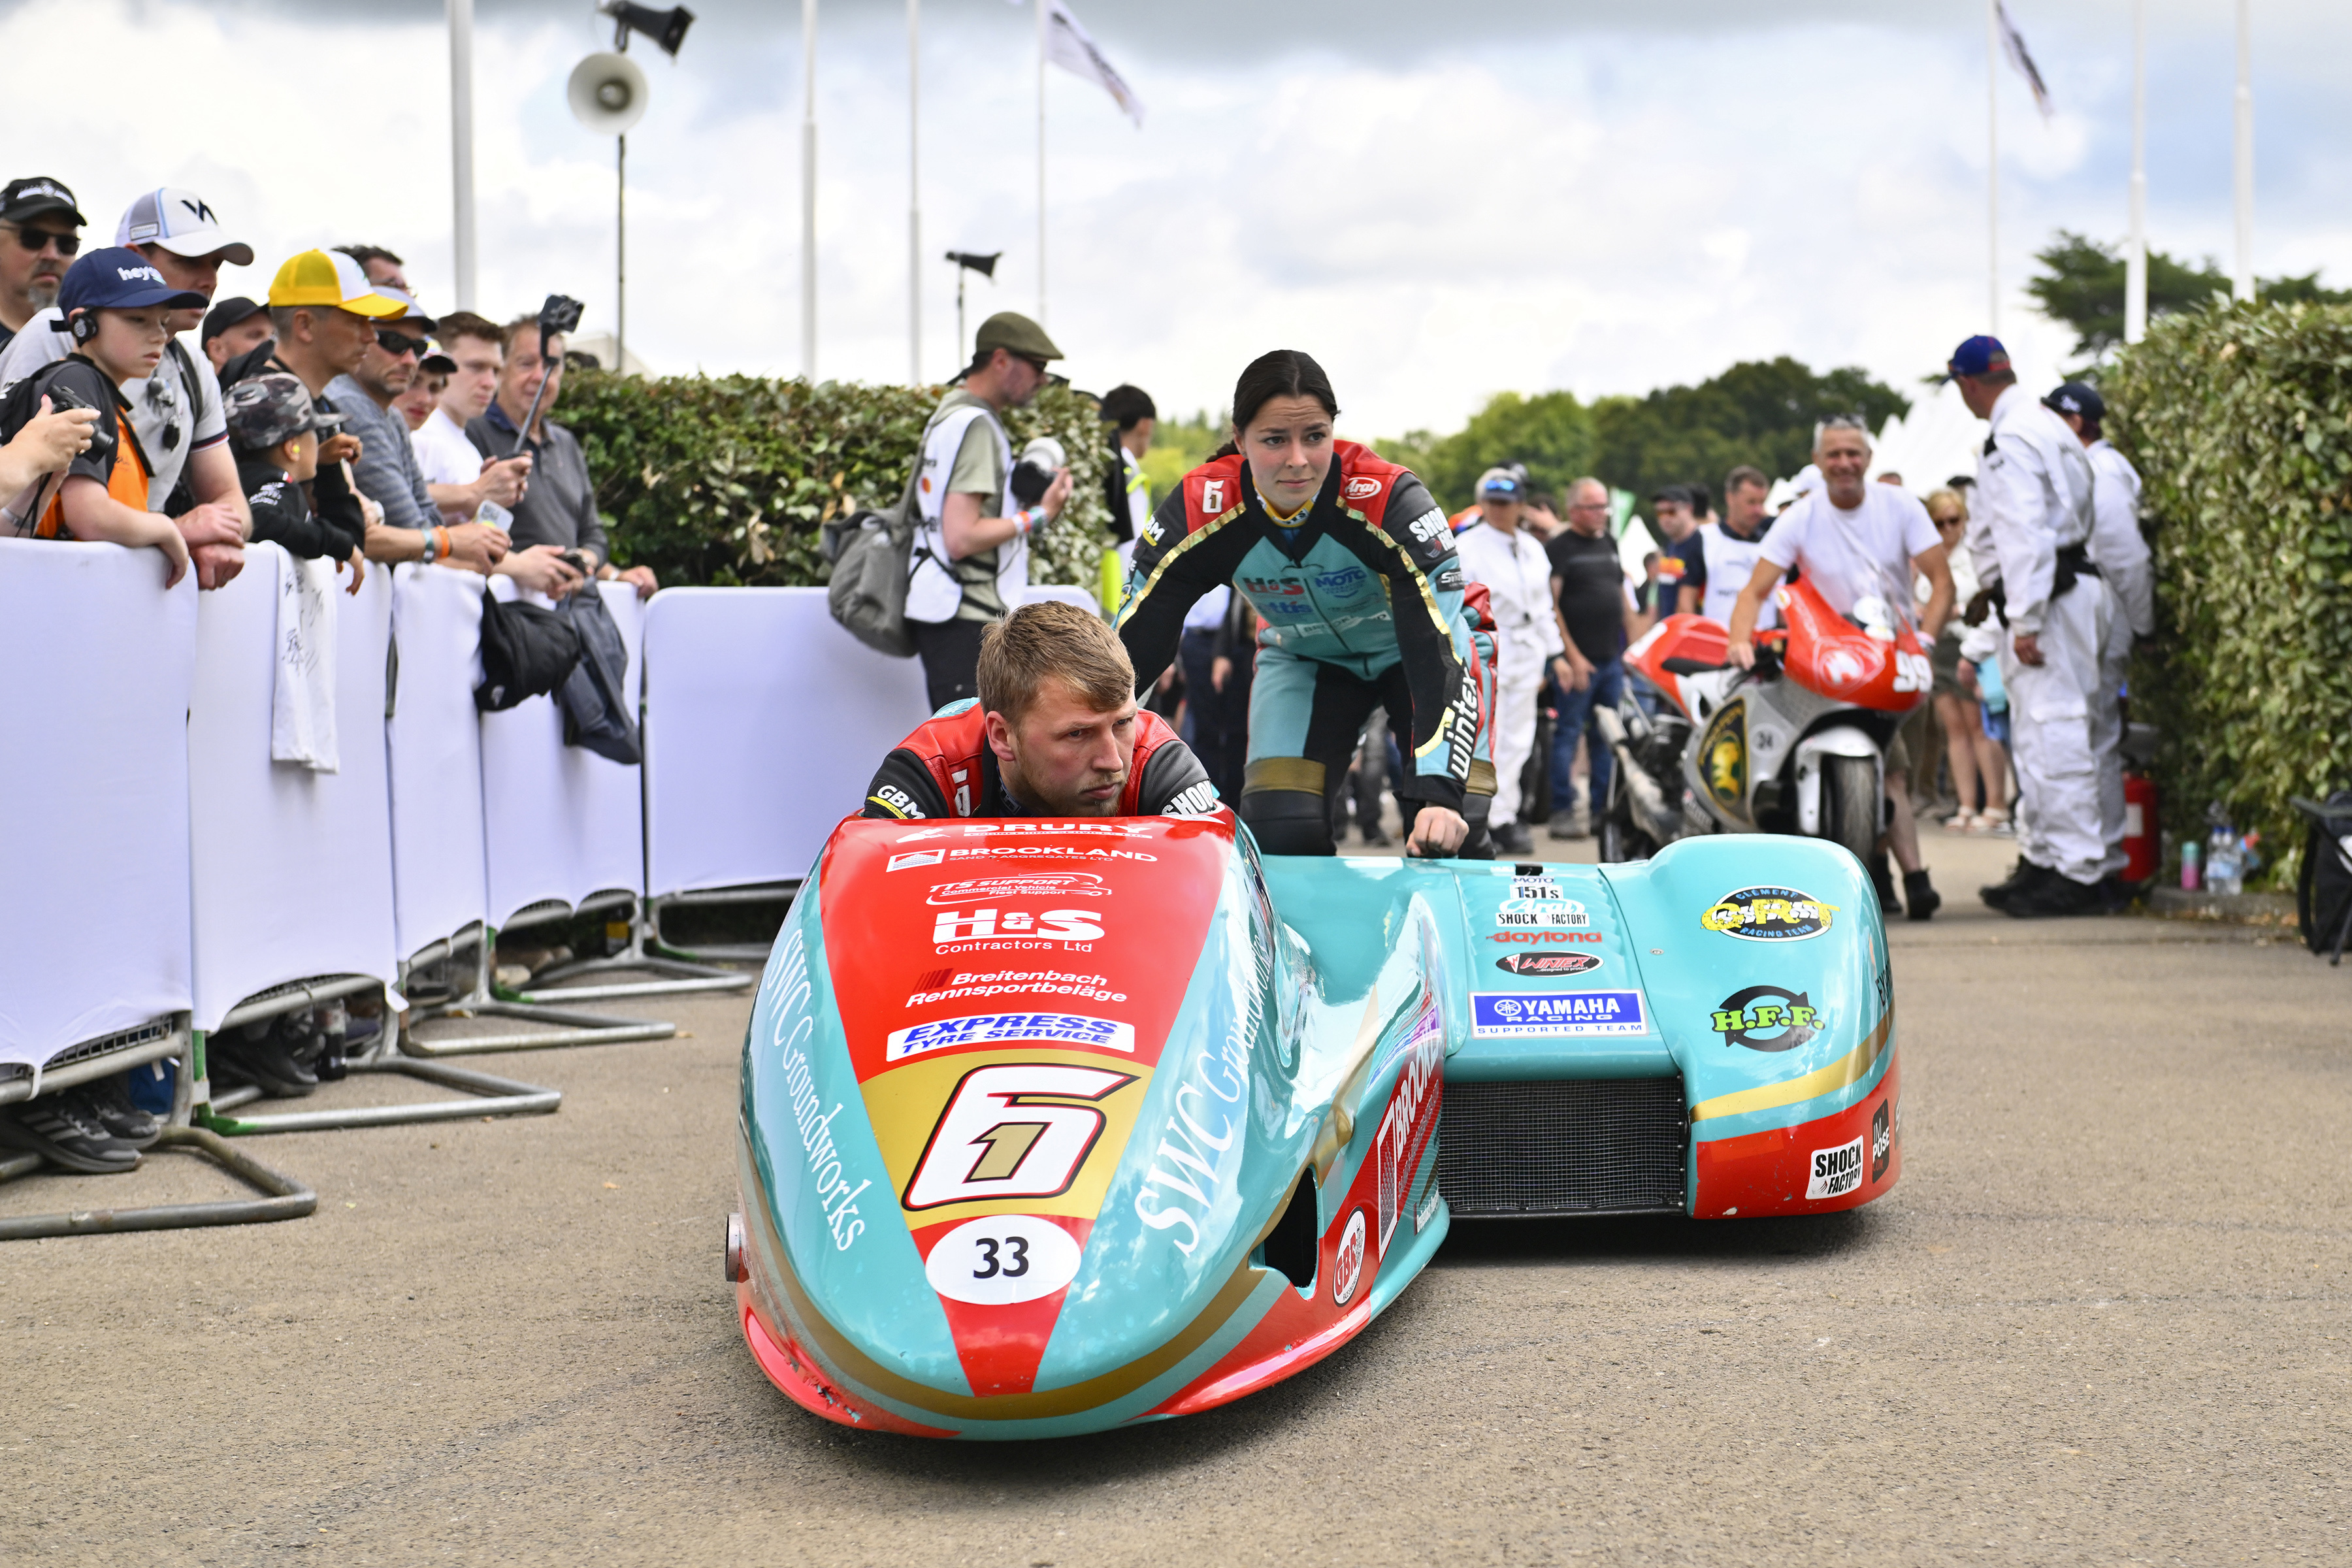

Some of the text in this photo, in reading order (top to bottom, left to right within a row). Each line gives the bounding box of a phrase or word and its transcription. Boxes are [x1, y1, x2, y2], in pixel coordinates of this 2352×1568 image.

[1345, 480, 1377, 493] Arai
[1145, 515, 1166, 542] BM
[877, 785, 926, 819] GBM
[964, 824, 1152, 834] DRURY
[950, 847, 1158, 862] BROOKLAND
[928, 880, 972, 892] TTS
[941, 886, 1013, 895] Commercial
[932, 909, 1105, 943] H&S
[1499, 913, 1586, 924] SHOCK FACTORY
[1494, 931, 1603, 945] daytona
[1740, 924, 1814, 938] RACING TEAM
[935, 940, 1092, 955] Contractors Ltd
[1520, 956, 1591, 969] WINTEX
[951, 970, 1107, 986] Breitenbach
[905, 981, 1128, 1008] Rennsportbeläge
[1522, 998, 1621, 1015] YAMAHA
[1506, 1014, 1613, 1022] RACING
[903, 1015, 1119, 1043] EXPRESS
[1478, 1026, 1584, 1034] SUPPORTED
[902, 1028, 1113, 1054] TYRE SERVICE
[783, 1015, 873, 1252] Groundworks
[901, 1062, 1142, 1212] 6
[1872, 1126, 1890, 1164] POSE
[1815, 1143, 1861, 1177] SHOCK
[1134, 1081, 1233, 1259] SWC
[1827, 1165, 1861, 1194] FACTORY
[973, 1236, 1030, 1279] 33
